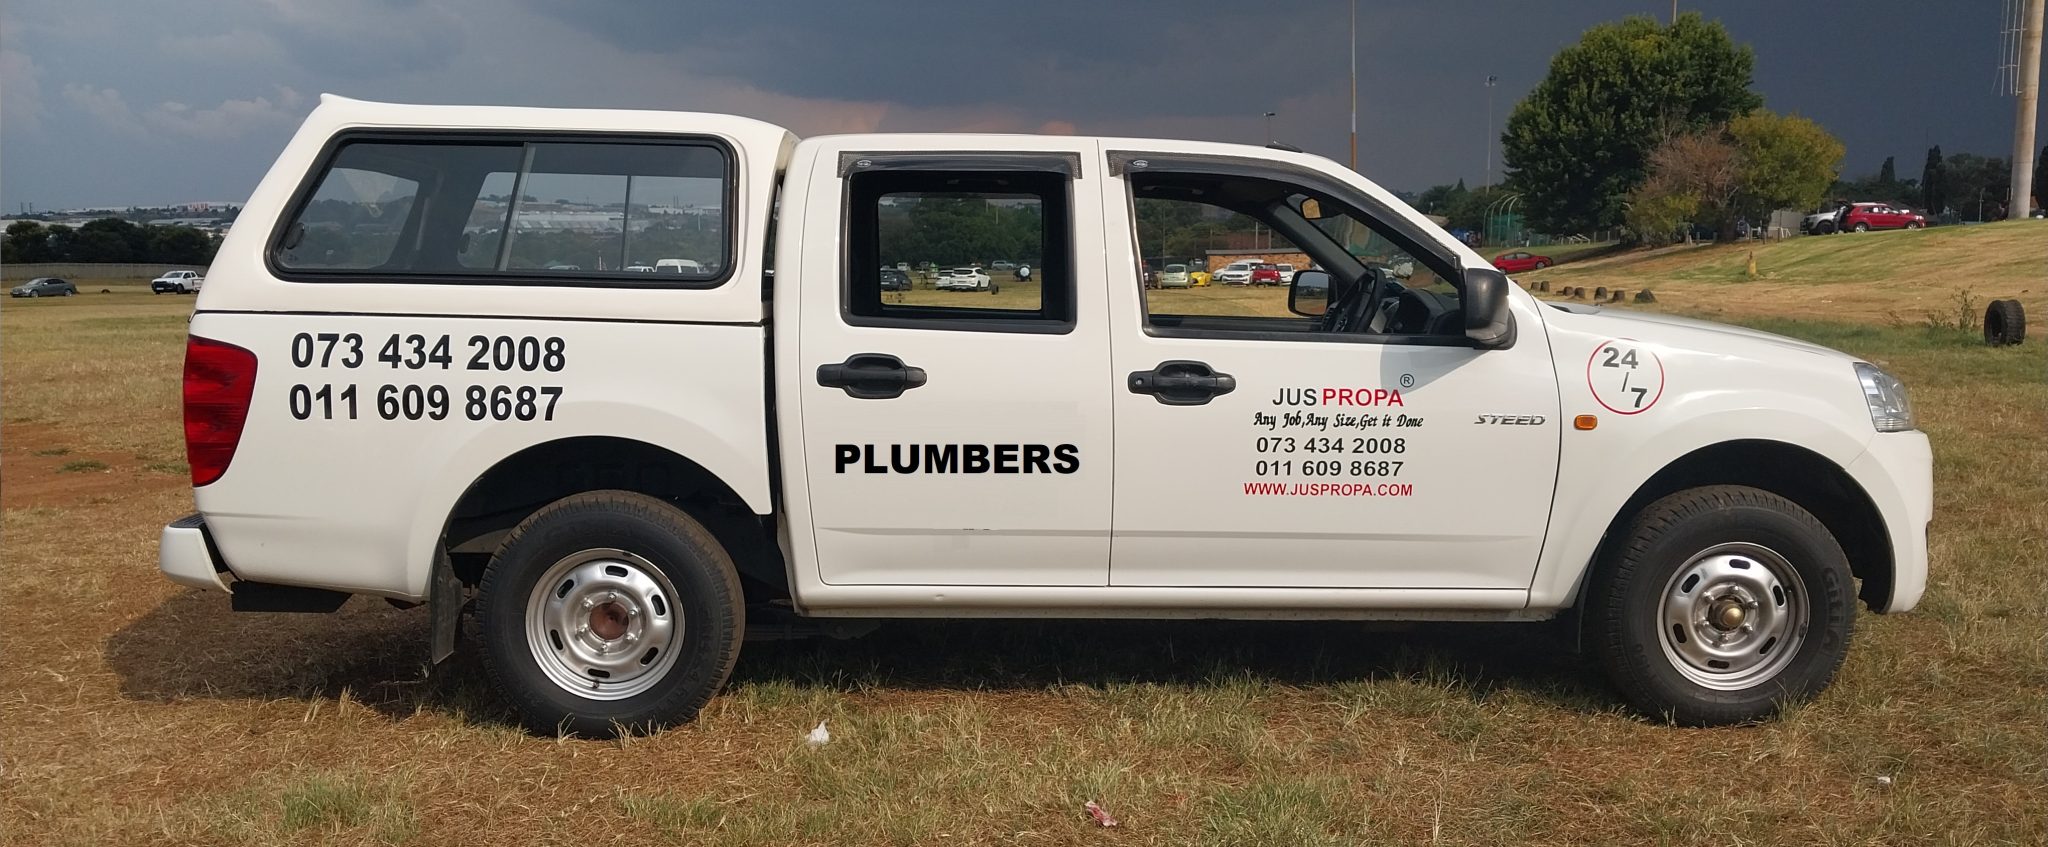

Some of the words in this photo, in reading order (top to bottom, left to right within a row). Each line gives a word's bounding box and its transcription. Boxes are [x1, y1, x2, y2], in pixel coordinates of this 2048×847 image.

[291, 332, 364, 369] 073
[378, 333, 453, 370] 434
[466, 334, 566, 373] 2008
[289, 383, 358, 421] 011
[376, 384, 450, 421] 609
[465, 384, 564, 422] 8687
[1272, 387, 1317, 407] JUS
[1322, 388, 1404, 407] PROPA
[1253, 411, 1277, 432] Any
[1381, 413, 1392, 428] it
[1396, 413, 1424, 428] Done
[1474, 414, 1546, 426] STEED
[1256, 436, 1296, 454] 073
[1303, 437, 1345, 454] 434
[1351, 437, 1406, 454] 2008
[835, 443, 1080, 475] PLUMBERS
[1255, 460, 1292, 476] 011
[1302, 460, 1342, 477] 609
[1349, 460, 1404, 477] 8687
[1244, 482, 1413, 497] WWW.JUSPROPA.COM
